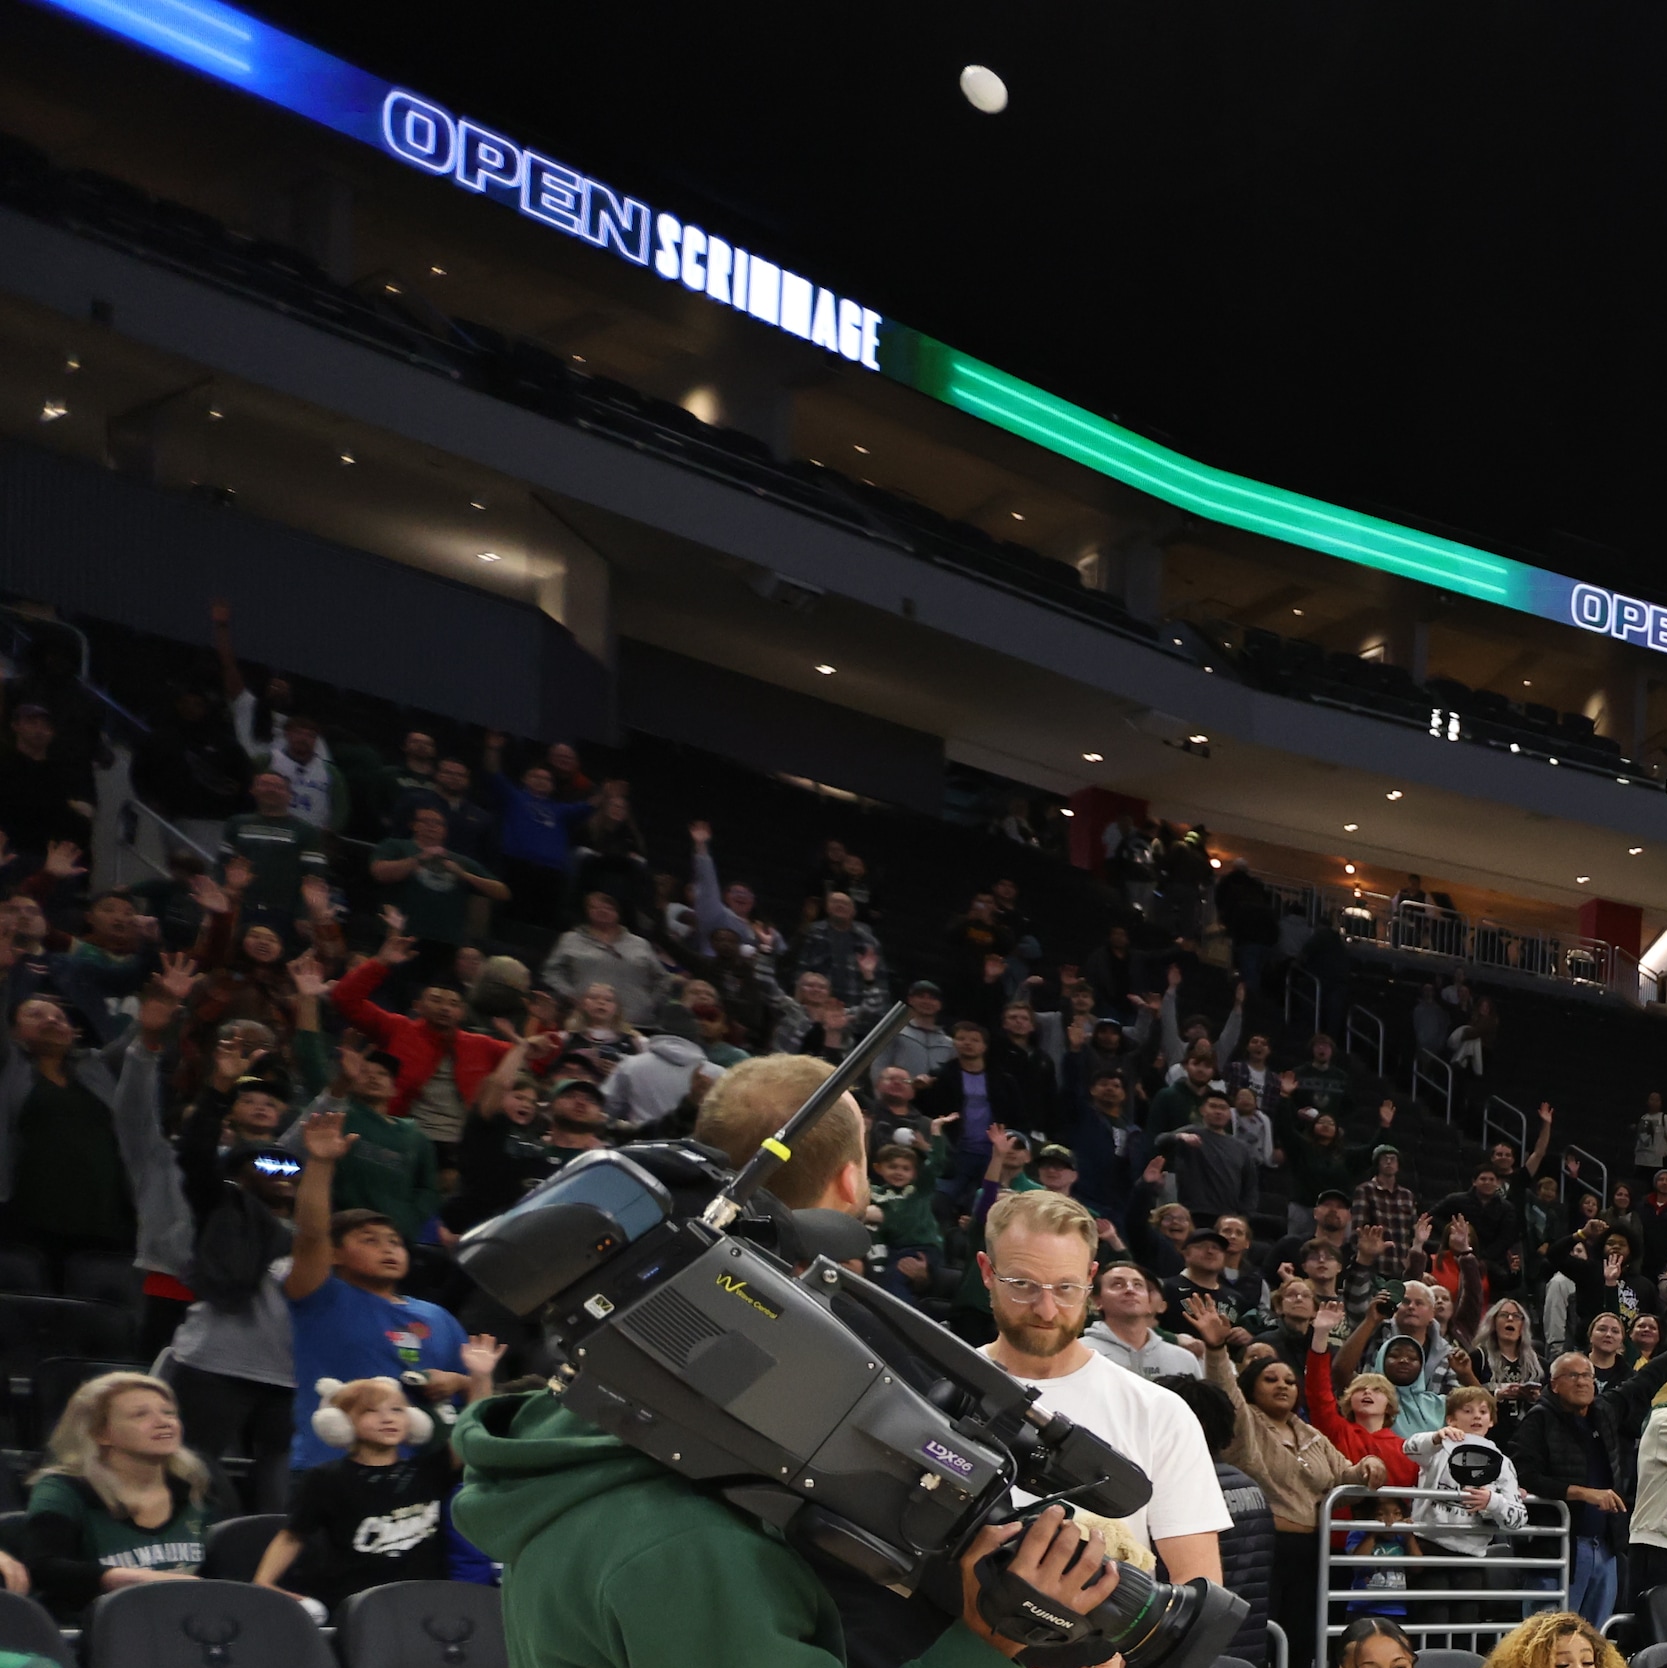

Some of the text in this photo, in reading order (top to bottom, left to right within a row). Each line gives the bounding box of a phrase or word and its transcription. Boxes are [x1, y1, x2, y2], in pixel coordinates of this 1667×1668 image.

[382, 87, 884, 372] OPEN SCRIMMAGE
[1022, 1600, 1074, 1631] FUJINON
